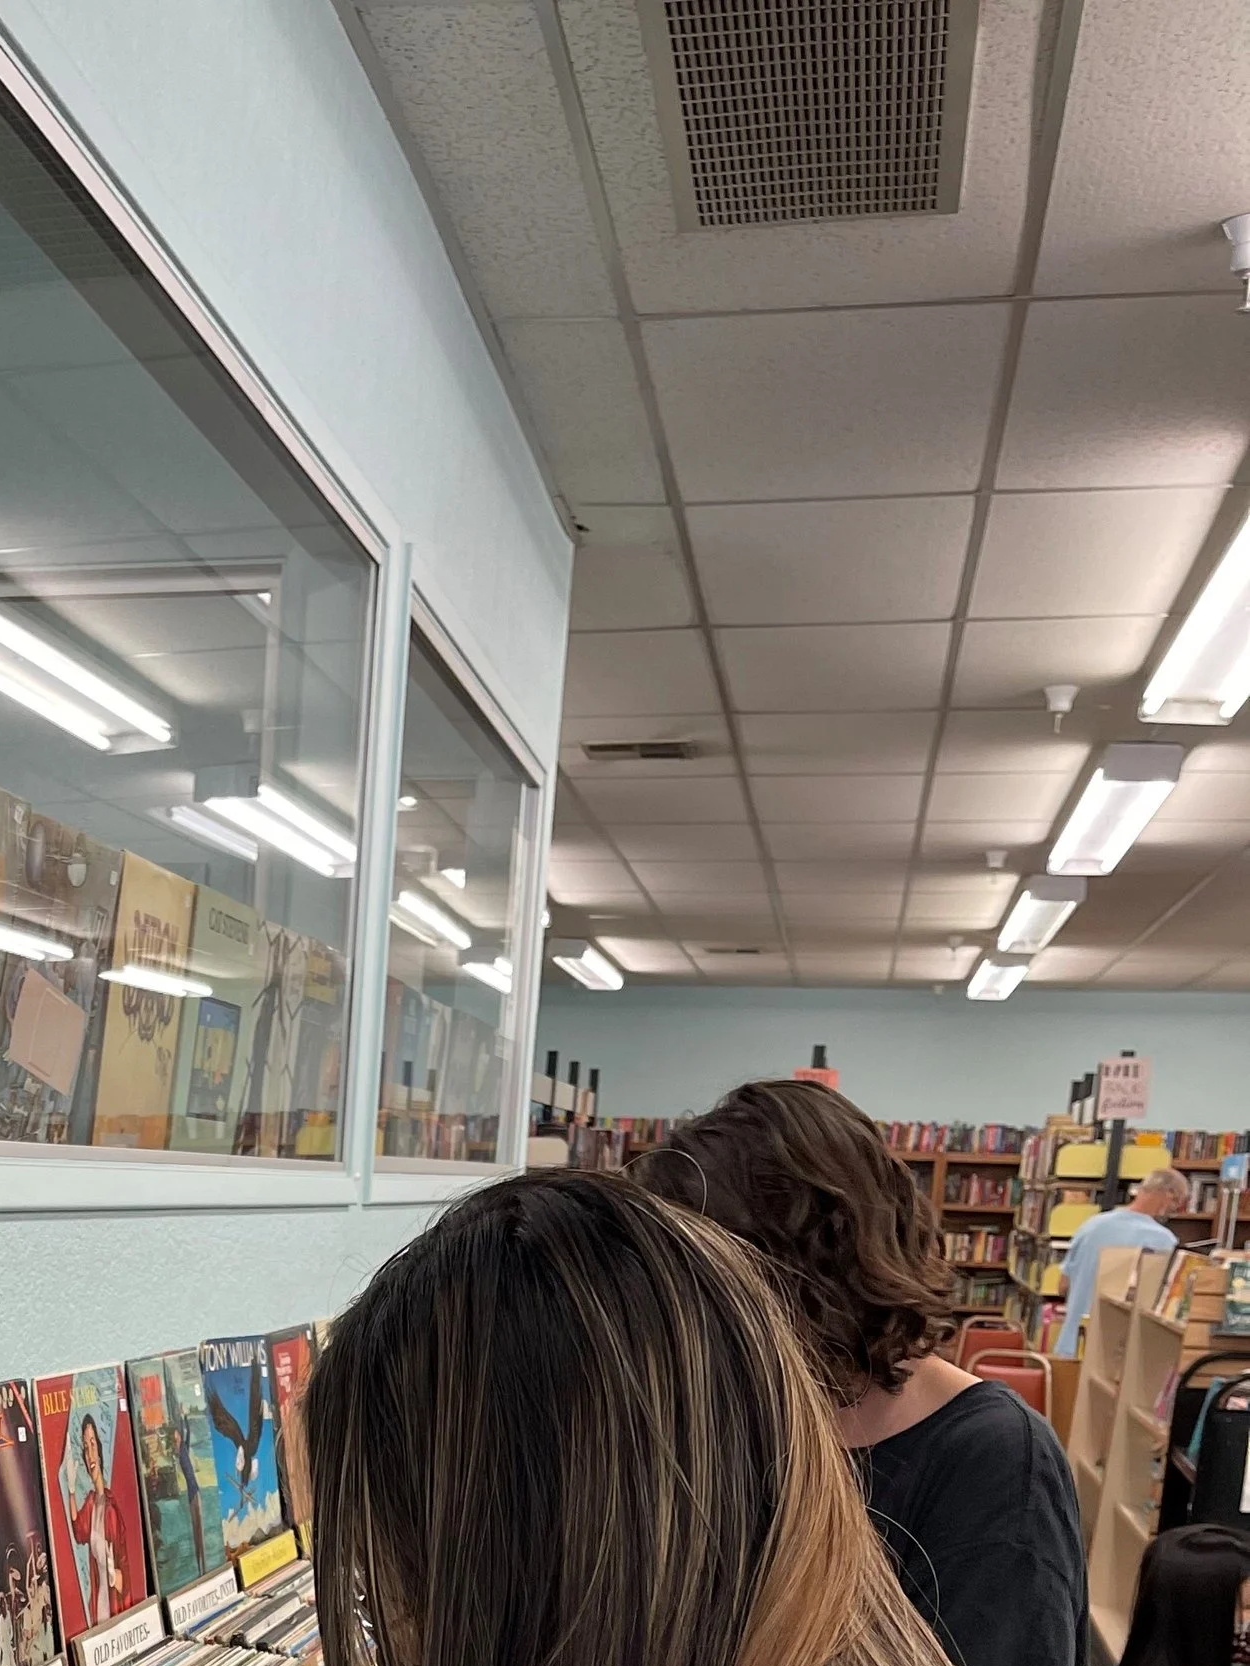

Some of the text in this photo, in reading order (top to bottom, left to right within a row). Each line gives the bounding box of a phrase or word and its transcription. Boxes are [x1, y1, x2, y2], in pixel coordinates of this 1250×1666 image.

[203, 1342, 228, 1372] TONY
[42, 1390, 69, 1417] BLUE
[94, 1640, 110, 1666] OLD
